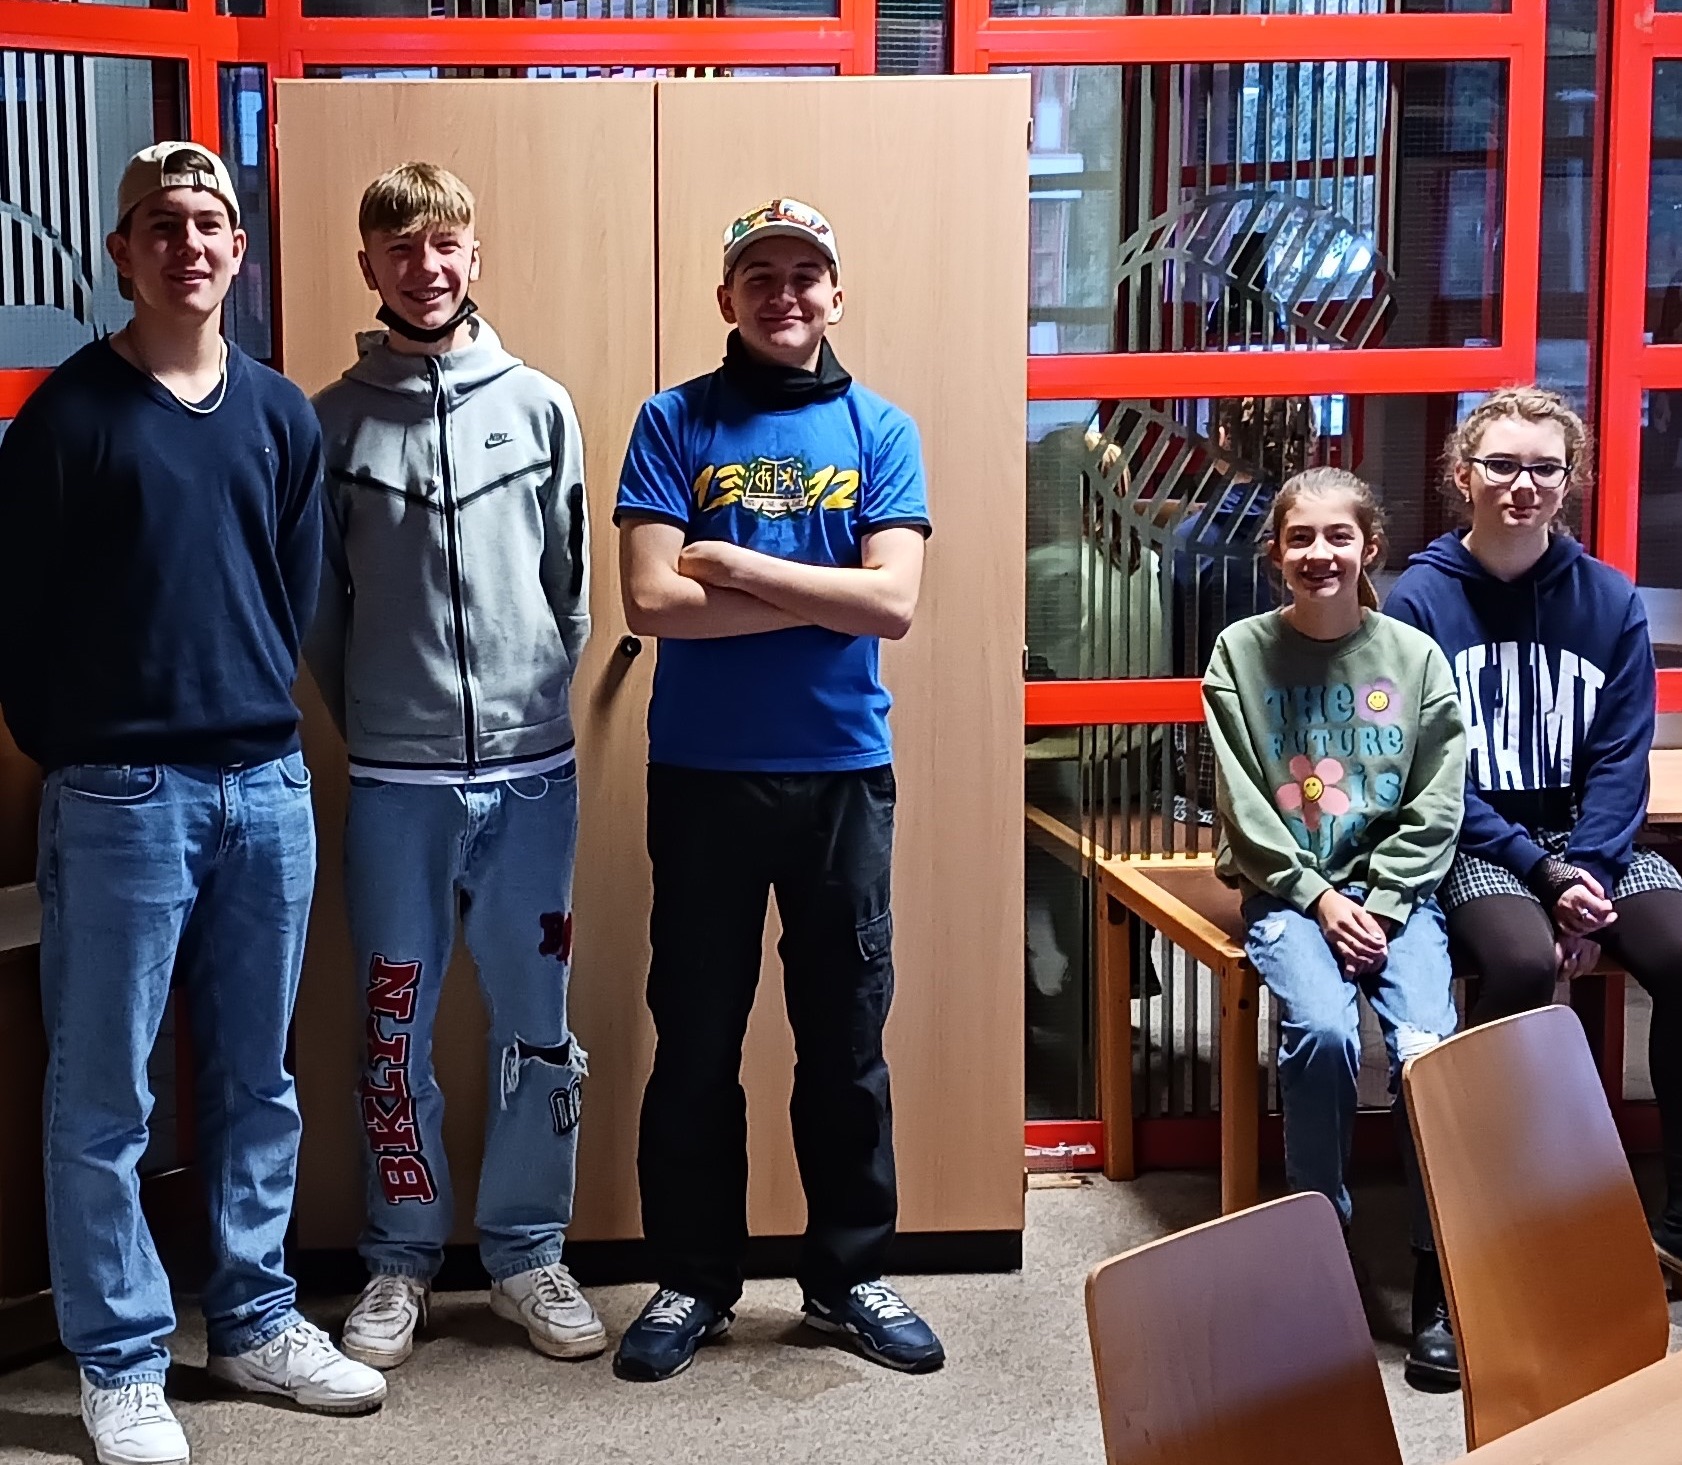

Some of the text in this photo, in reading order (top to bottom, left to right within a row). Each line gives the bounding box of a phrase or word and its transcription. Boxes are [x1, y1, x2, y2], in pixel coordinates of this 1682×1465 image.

[808, 464, 861, 510] 12
[1264, 683, 1356, 725] THE
[1267, 724, 1404, 761] FUTURE
